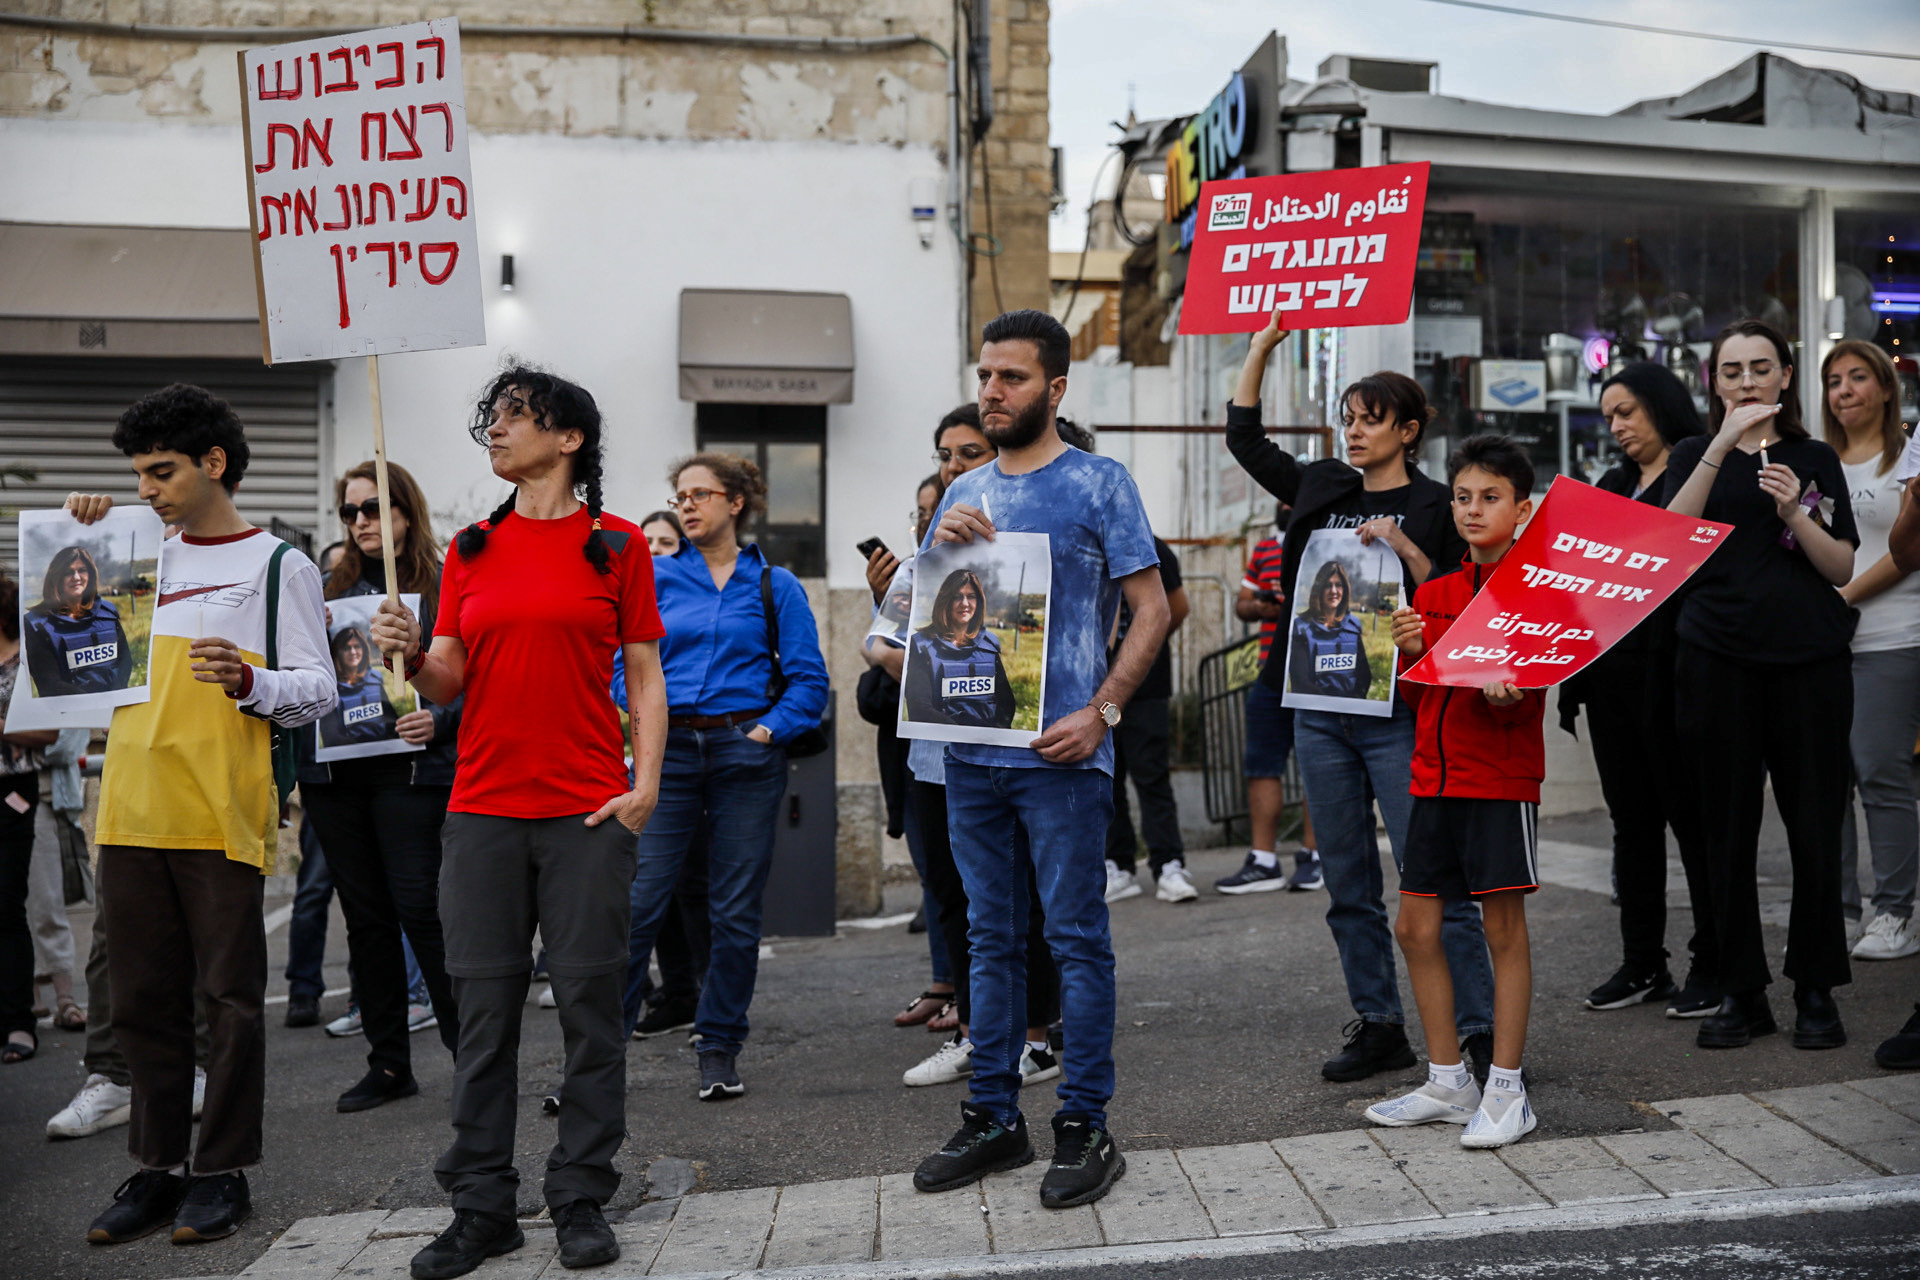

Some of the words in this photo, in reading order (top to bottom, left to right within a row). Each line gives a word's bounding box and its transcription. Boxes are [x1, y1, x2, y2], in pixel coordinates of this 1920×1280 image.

[257, 37, 446, 101] הכיבוש
[255, 117, 334, 174] את
[361, 102, 454, 162] רצח
[1166, 71, 1246, 224] METRO
[1253, 192, 1341, 231] الاحتلال
[1222, 234, 1388, 273] מתנגדים
[330, 242, 460, 329] סירין
[1228, 273, 1369, 314] לכיבוש
[1551, 532, 1624, 564] נשים
[1624, 551, 1670, 573] דם
[1521, 563, 1596, 594] הפקר
[1595, 581, 1654, 603] אינו
[1550, 628, 1595, 644] دم
[74, 644, 115, 665] PRESS
[1320, 655, 1353, 669] PRESS
[1447, 644, 1518, 666] رخيص
[1513, 646, 1576, 667] مش
[949, 678, 991, 694] PRESS
[348, 704, 380, 721] PRESS
